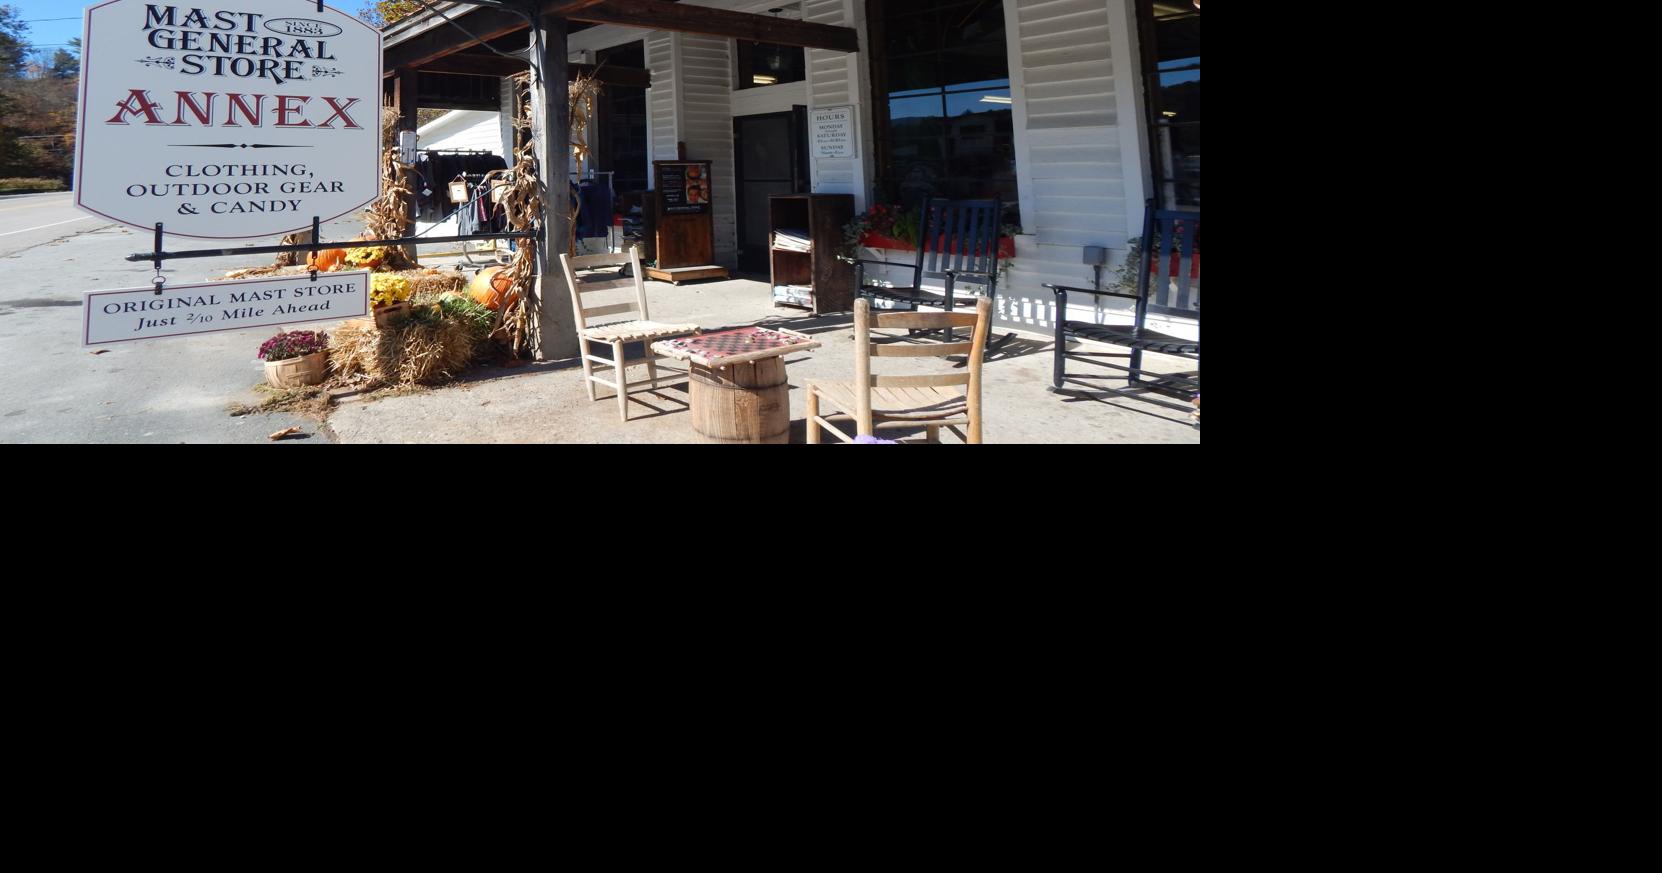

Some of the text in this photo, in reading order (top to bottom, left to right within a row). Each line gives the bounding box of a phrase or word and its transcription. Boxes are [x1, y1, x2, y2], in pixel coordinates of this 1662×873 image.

[142, 4, 264, 33] MAST
[285, 20, 320, 29] SINCE
[286, 26, 324, 36] 1883
[148, 28, 337, 61] GENERAL
[180, 54, 307, 85] STORE
[105, 89, 364, 130] ANNEX
[165, 164, 314, 178] CLOTHING,
[126, 181, 345, 197] OUTDOOR GEAR
[177, 200, 302, 216] & CANDY
[103, 282, 356, 315] ORIGINAL MAST STORE
[134, 300, 332, 332] Just 2/10 Mile Ahead
